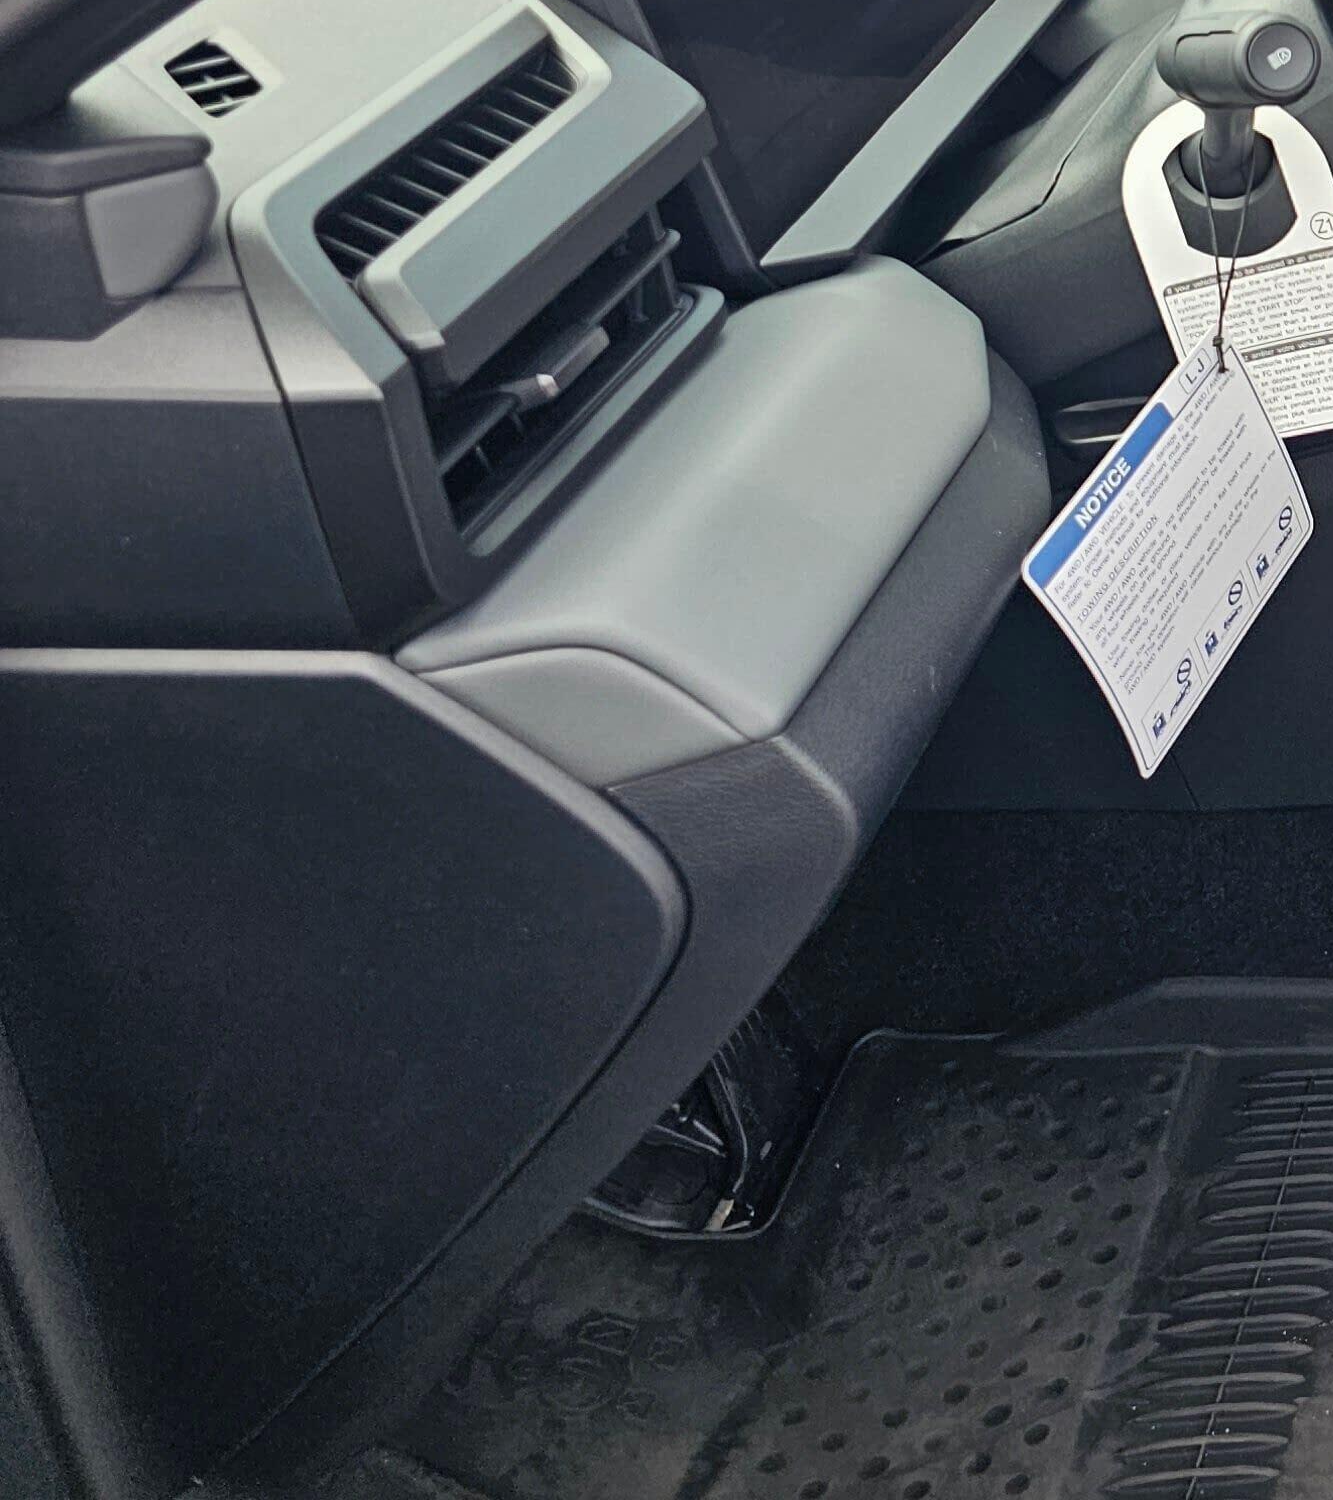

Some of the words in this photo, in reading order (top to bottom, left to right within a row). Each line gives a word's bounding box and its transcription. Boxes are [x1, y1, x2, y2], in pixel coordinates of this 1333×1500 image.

[1315, 217, 1333, 236] Z1
[1075, 457, 1132, 529] NOTICE
[1077, 579, 1108, 624] TOWING
[1108, 512, 1157, 583] DESCRIPTION
